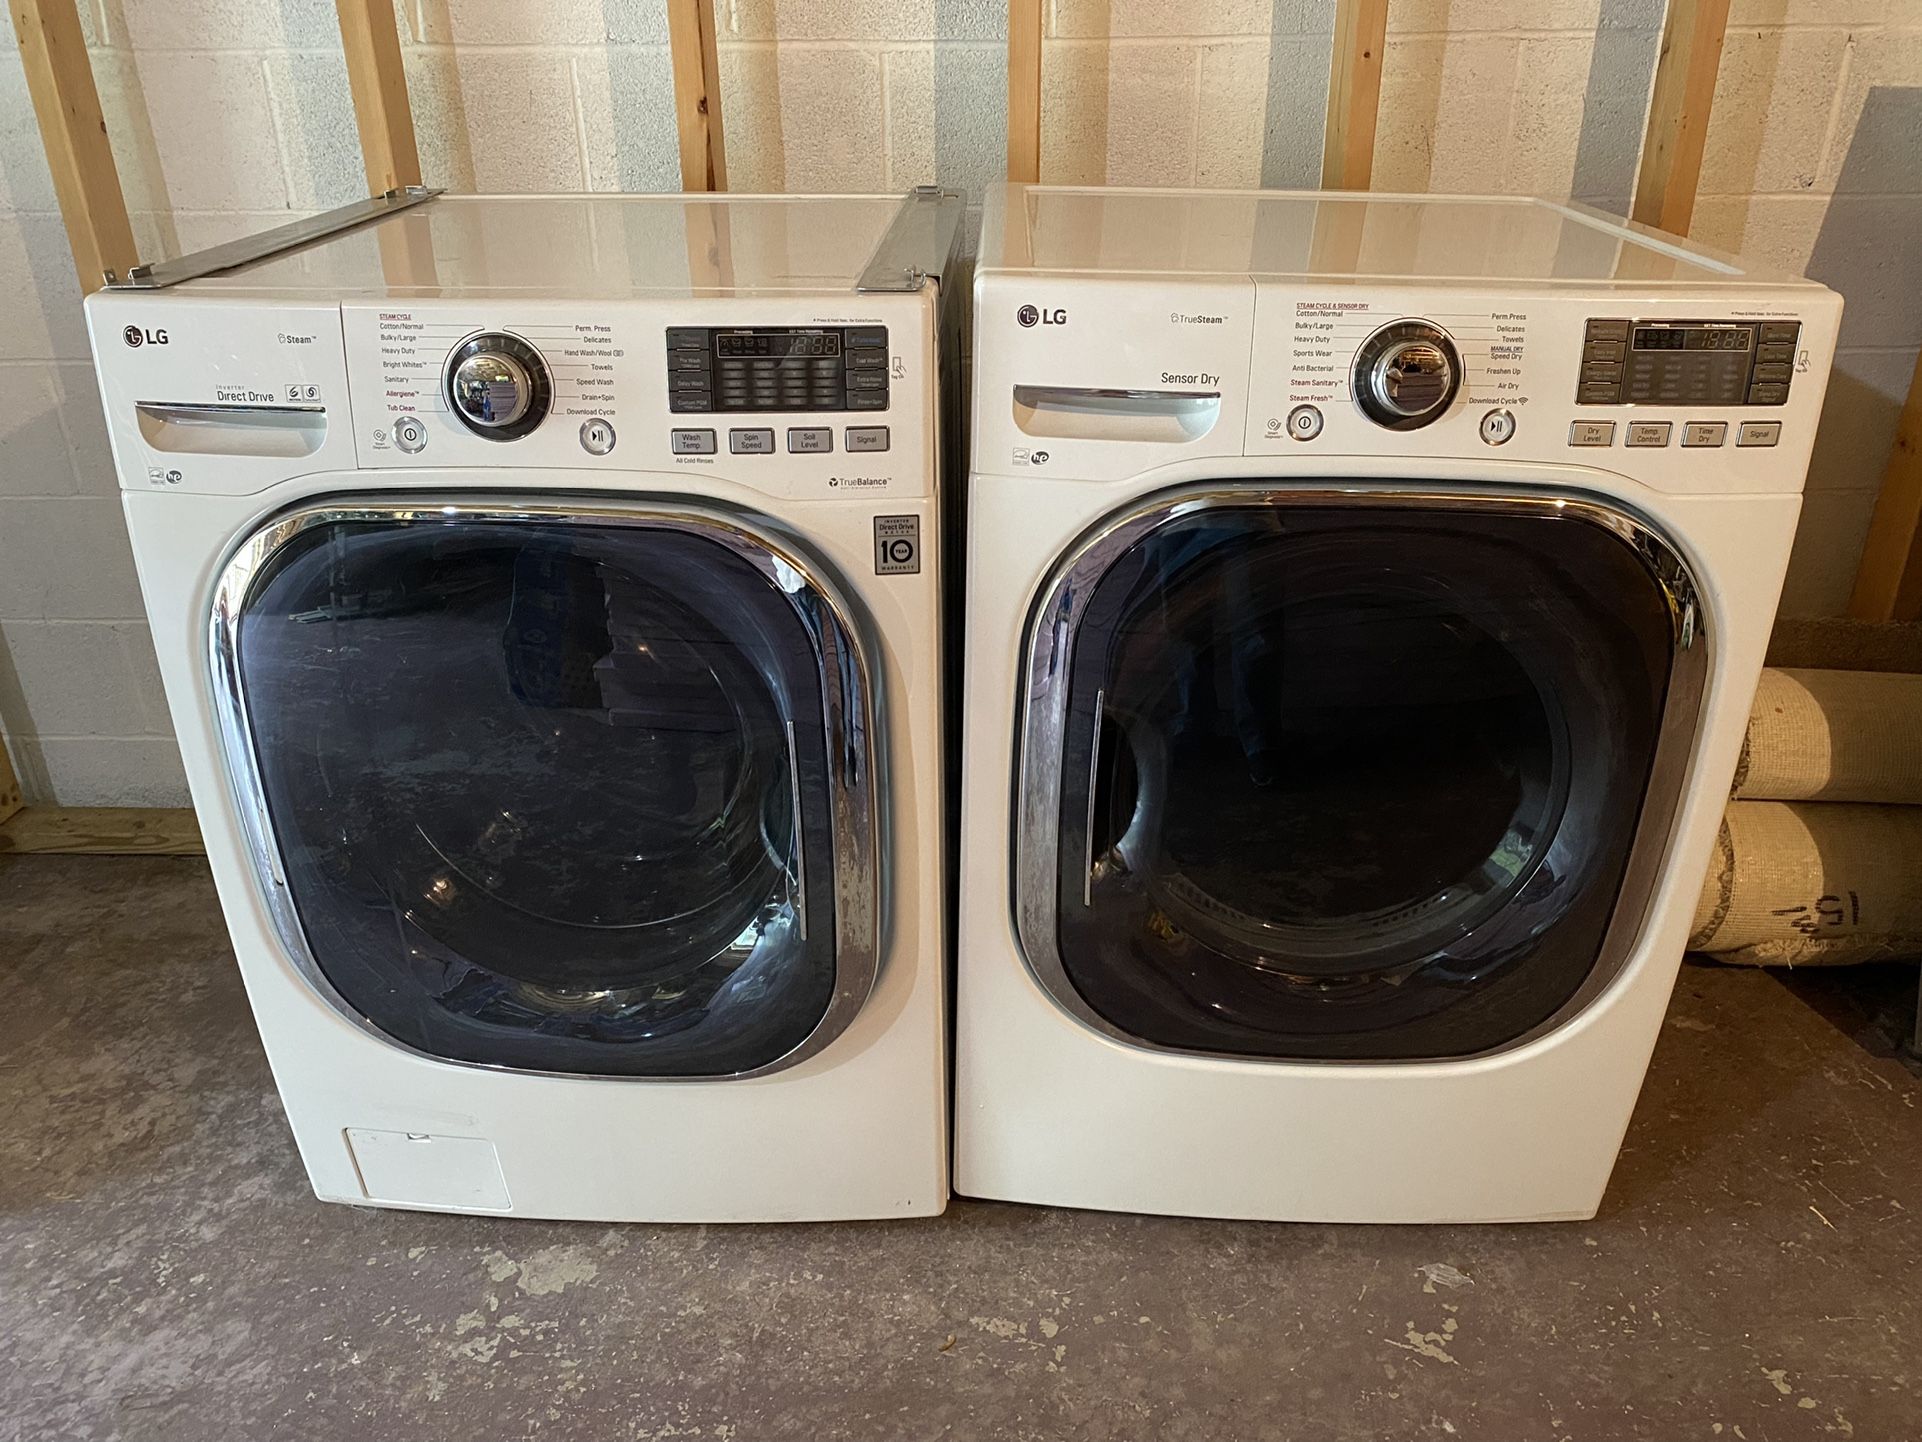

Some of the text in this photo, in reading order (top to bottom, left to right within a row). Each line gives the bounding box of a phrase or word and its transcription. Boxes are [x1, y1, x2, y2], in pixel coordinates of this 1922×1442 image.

[1042, 309, 1066, 324] LG
[145, 329, 169, 344] LG
[1161, 372, 1220, 387] Sensor Dry
[217, 391, 274, 402] Direct Drive
[881, 539, 913, 563] 10
